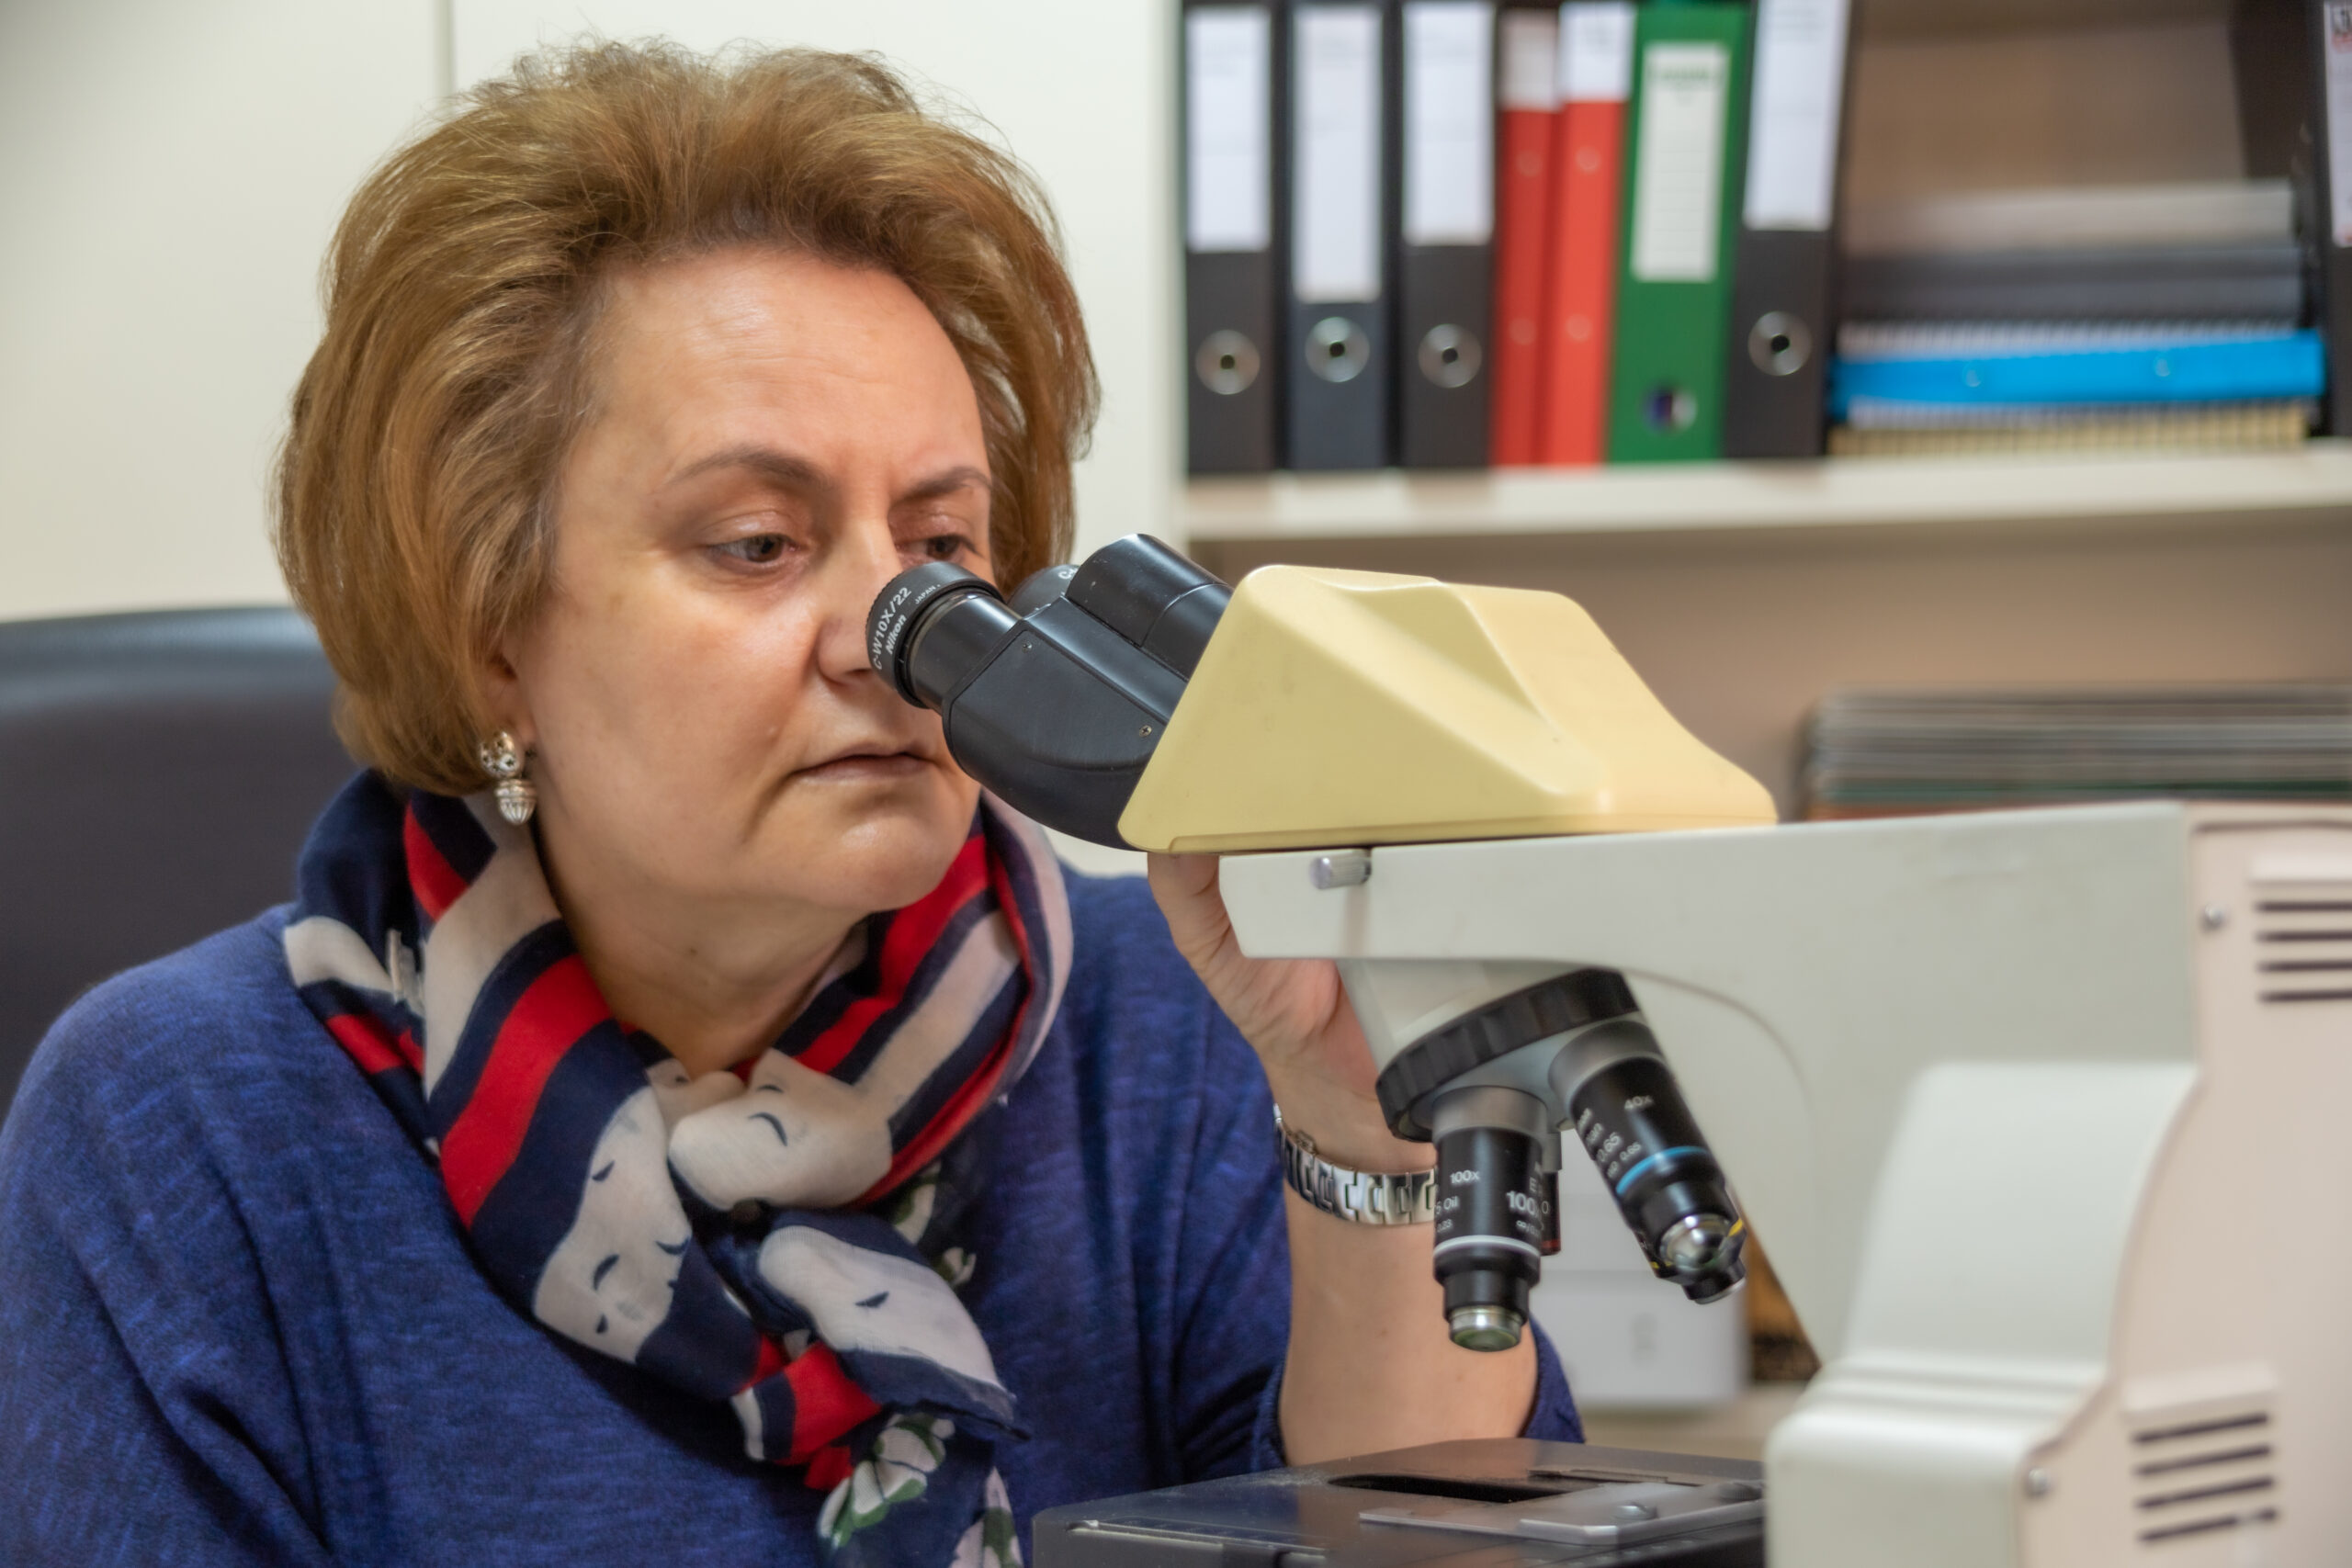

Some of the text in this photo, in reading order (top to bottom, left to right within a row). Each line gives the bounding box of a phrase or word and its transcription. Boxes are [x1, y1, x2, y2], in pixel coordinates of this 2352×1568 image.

[915, 585, 936, 604] JAPAN
[872, 587, 912, 670] C-W10X/22
[885, 615, 907, 655] Nikon
[1624, 1095, 1654, 1110] 40x
[1450, 1169, 1480, 1184] 100x
[1443, 1196, 1460, 1211] Oil
